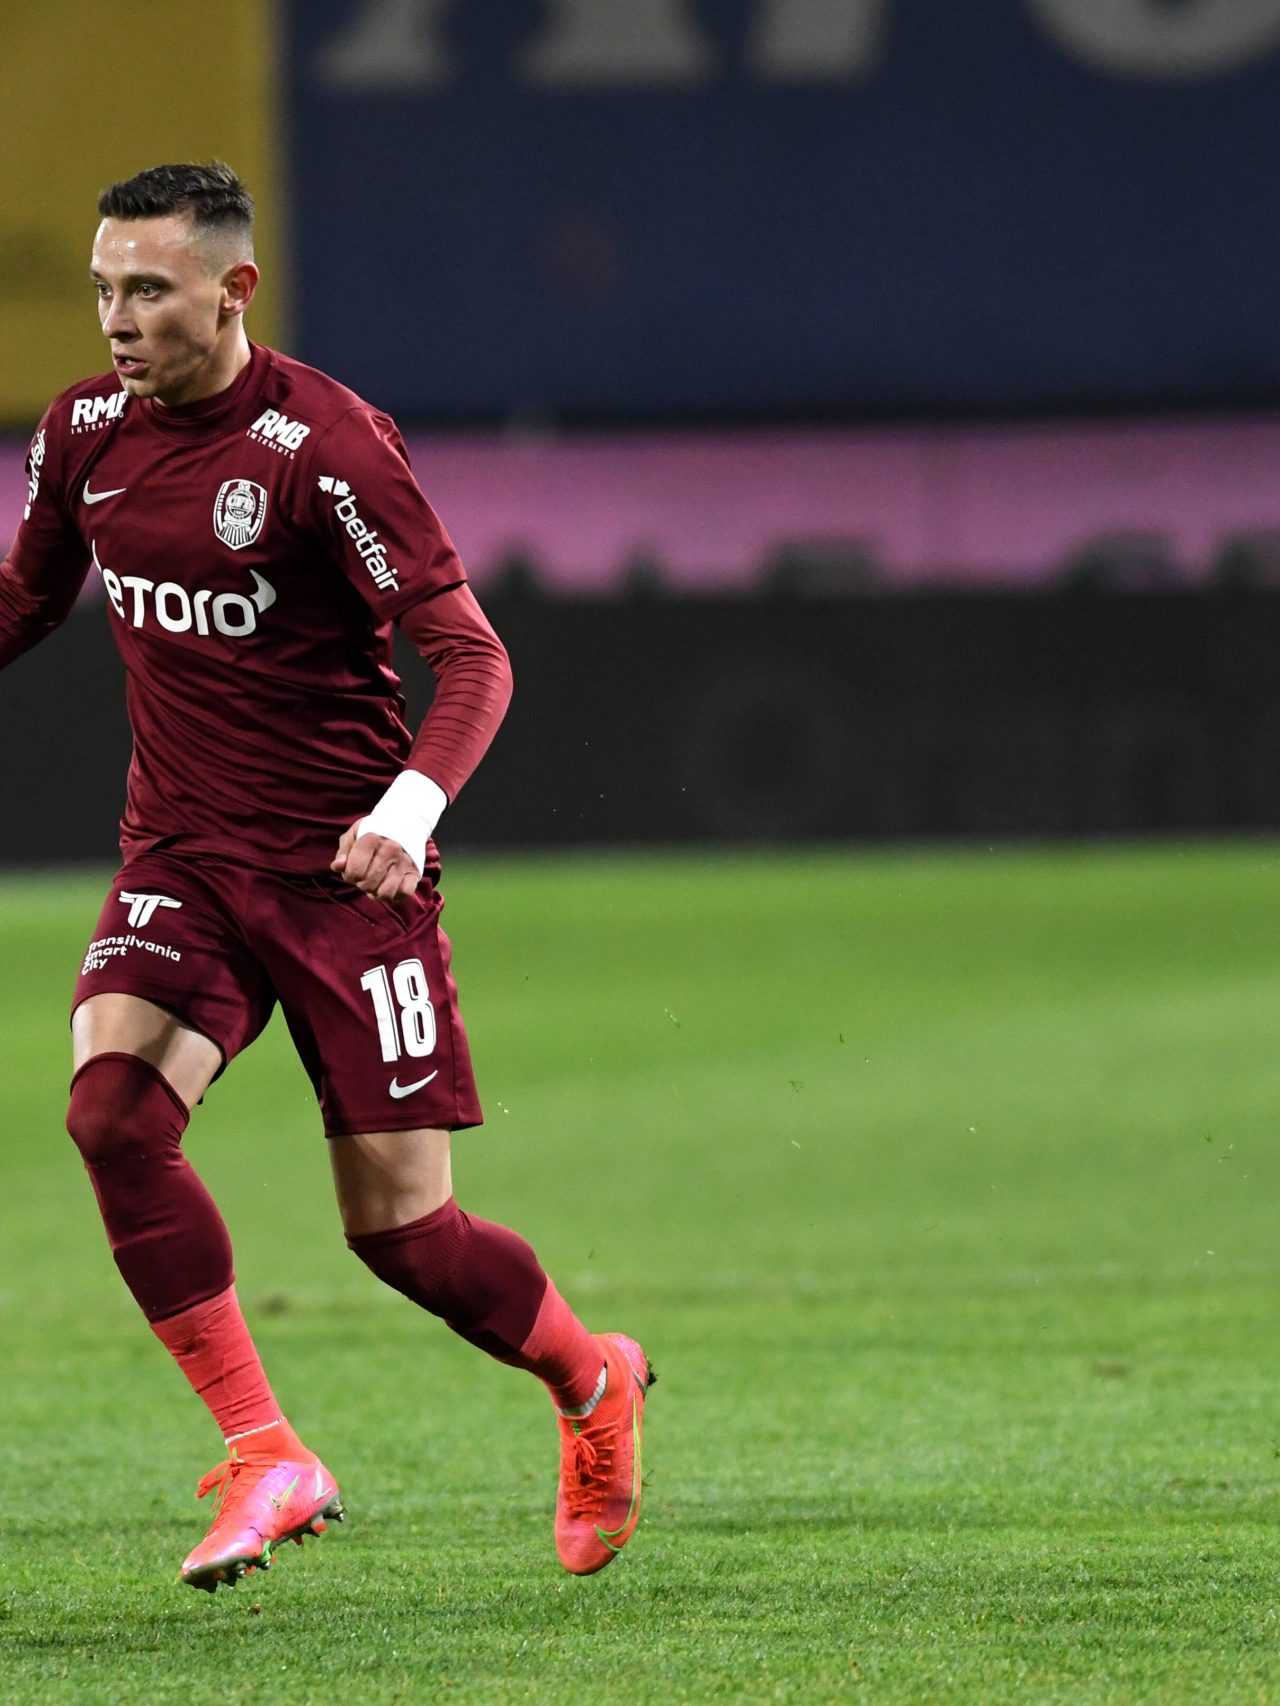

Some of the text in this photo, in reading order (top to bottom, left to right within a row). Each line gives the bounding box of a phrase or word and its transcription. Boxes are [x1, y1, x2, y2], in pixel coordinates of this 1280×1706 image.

[246, 429, 295, 460] INTERAUTO
[250, 408, 310, 450] RMB
[334, 495, 399, 591] betfair
[360, 958, 436, 1062] 18
